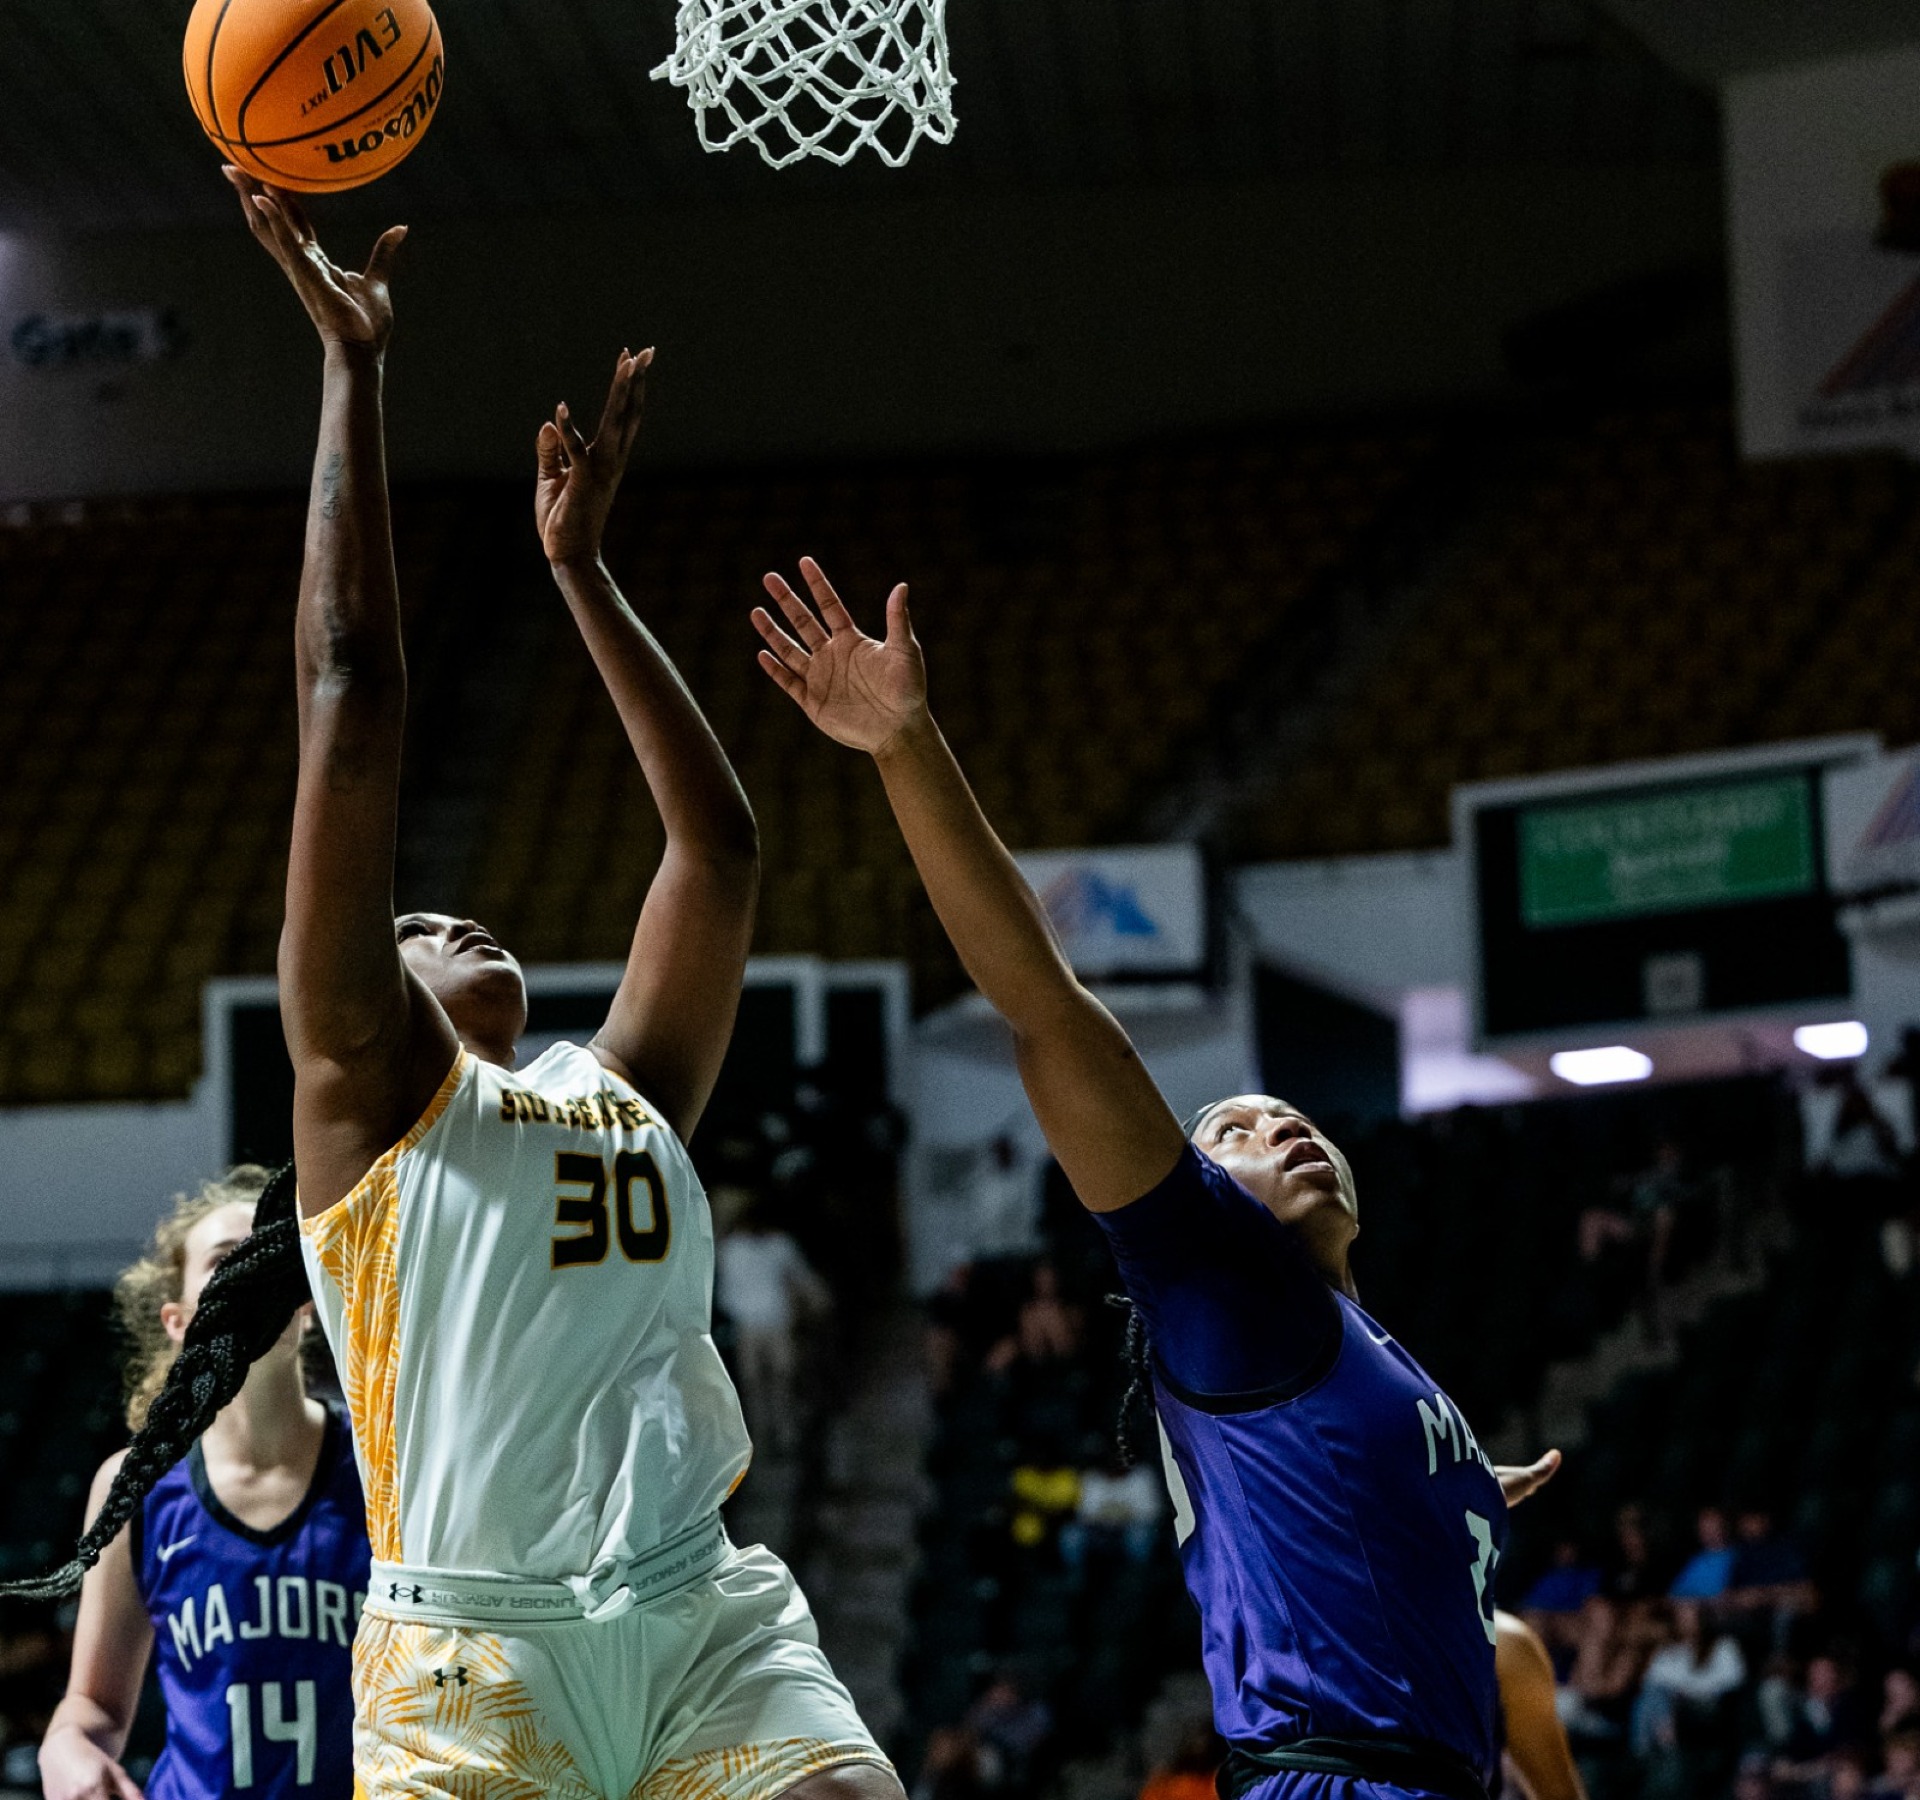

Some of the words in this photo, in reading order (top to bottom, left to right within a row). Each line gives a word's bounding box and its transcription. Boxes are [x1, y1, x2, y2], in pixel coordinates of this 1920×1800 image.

[322, 7, 402, 95] EVO
[300, 88, 329, 117] NXT
[551, 1150, 672, 1271] 30
[1416, 1392, 1496, 1480] MA
[509, 1596, 577, 1610] UNDER
[226, 1679, 318, 1790] 14
